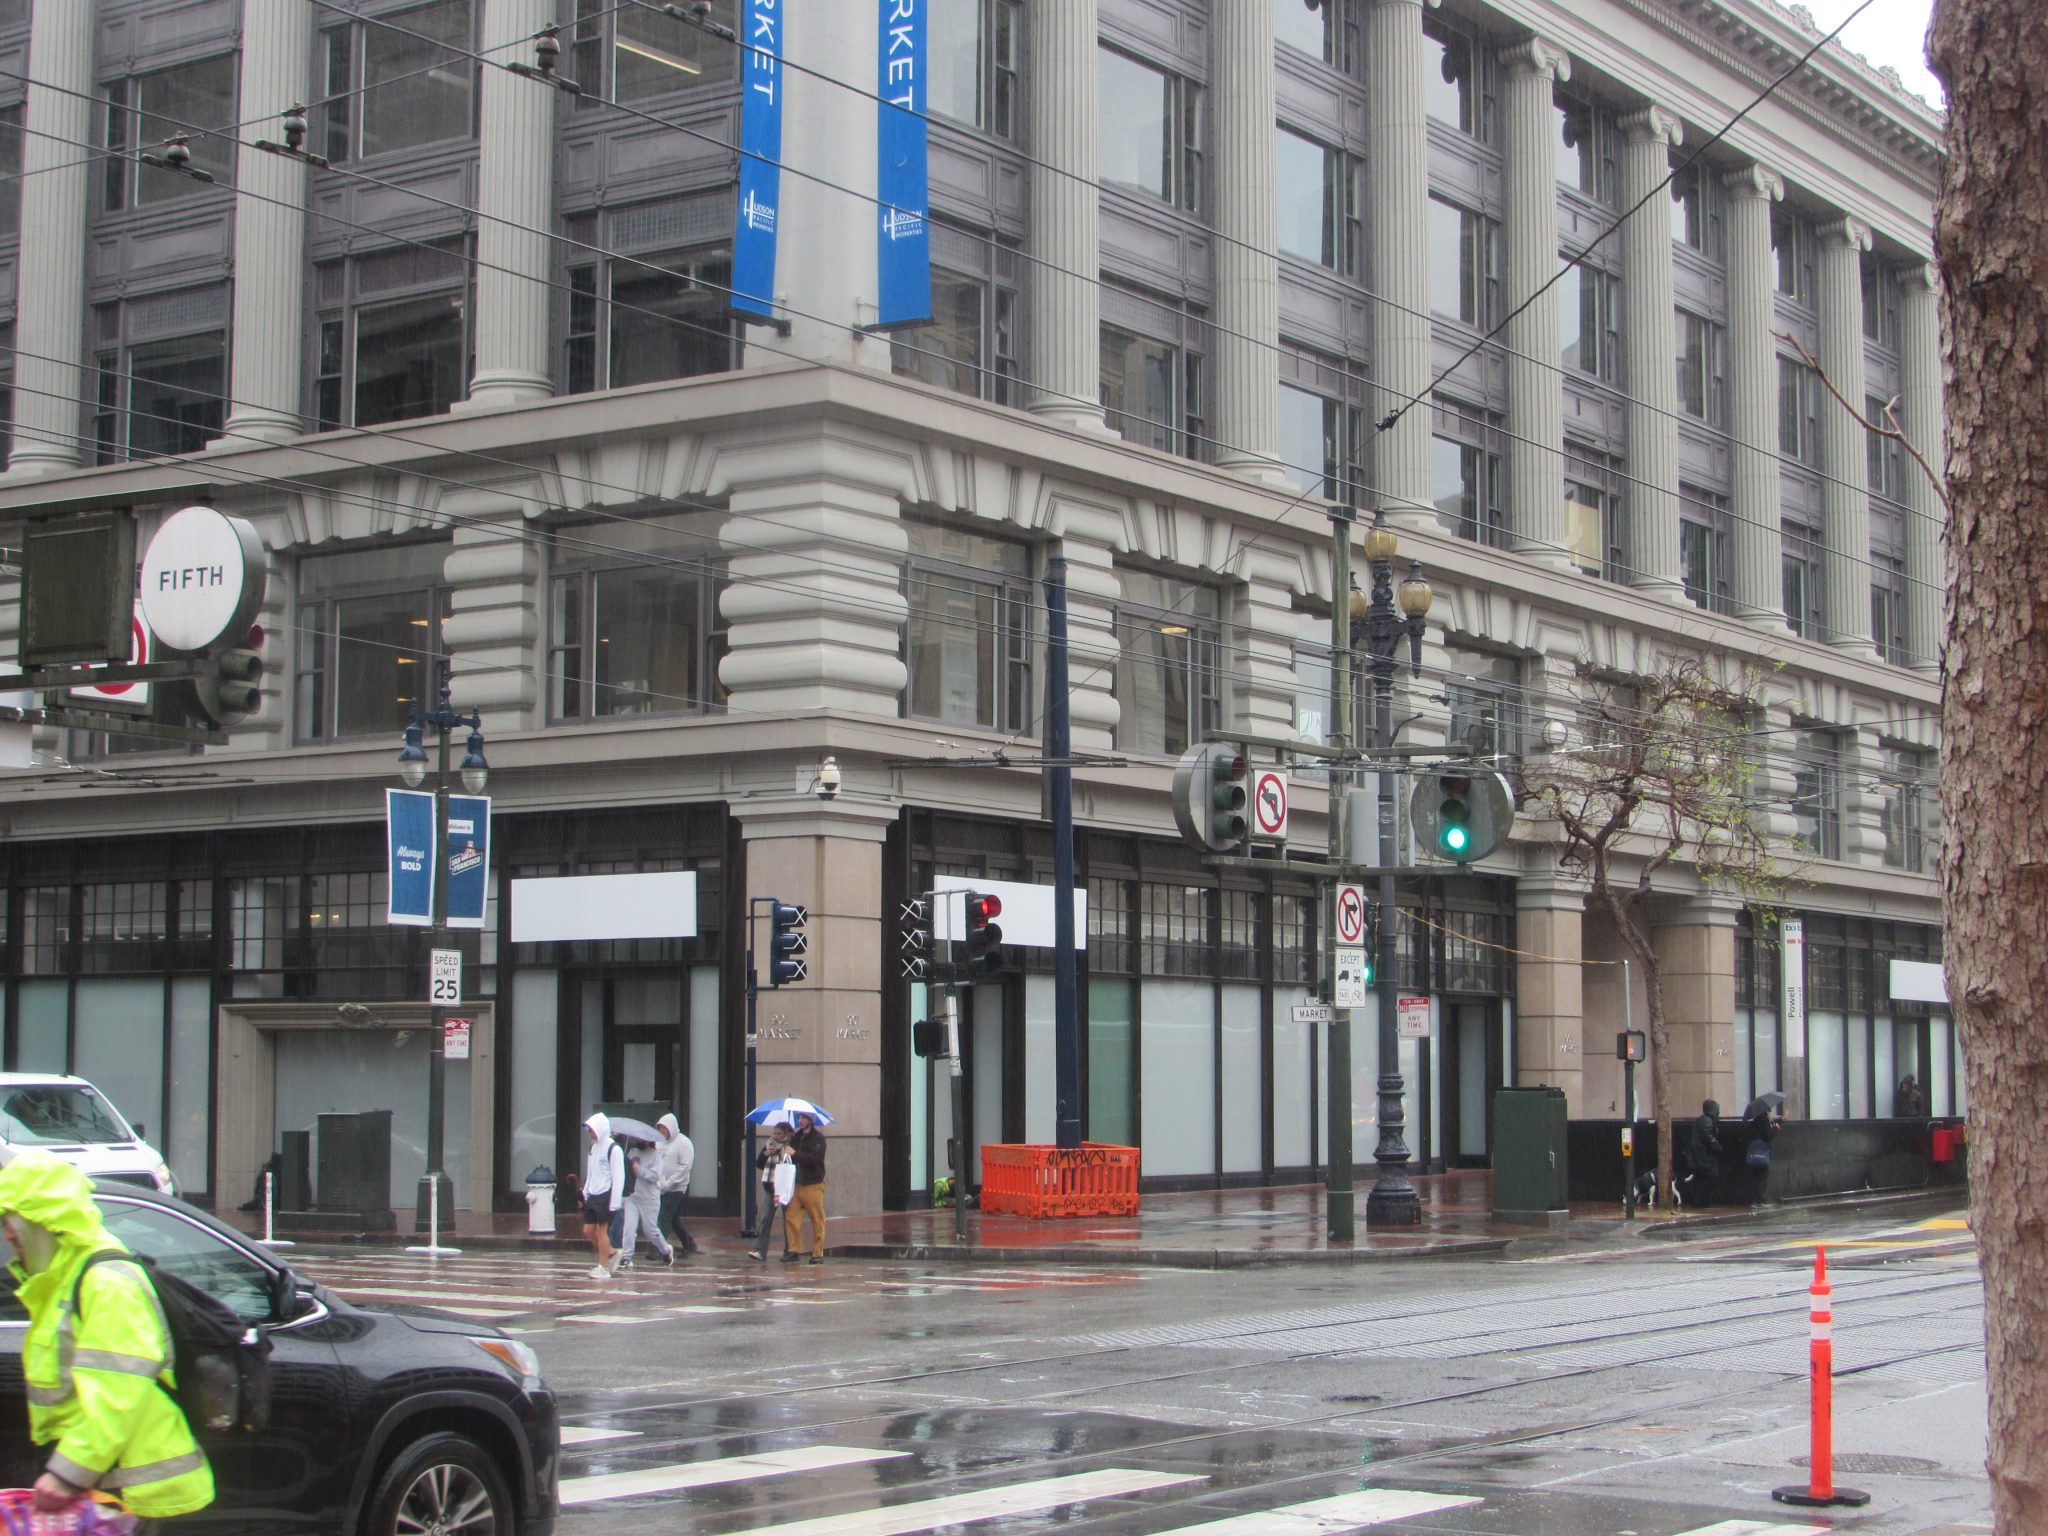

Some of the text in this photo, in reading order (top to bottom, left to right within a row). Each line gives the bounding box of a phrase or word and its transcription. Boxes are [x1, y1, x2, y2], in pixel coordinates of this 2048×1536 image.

[744, 189, 775, 230] HUDSON
[883, 203, 922, 241] HUDSON
[159, 565, 223, 591] FIFTH
[397, 845, 425, 861] Always
[401, 861, 422, 871] BOLD
[453, 855, 481, 872] FRANCISCO
[434, 955, 459, 966] SPEED
[1340, 954, 1360, 964] EXCEPT
[436, 968, 456, 976] LIMIT
[433, 979, 457, 1000] 25
[1787, 987, 1796, 1019] Powell
[1300, 1009, 1328, 1019] MARKET
[446, 1039, 455, 1047] ANY
